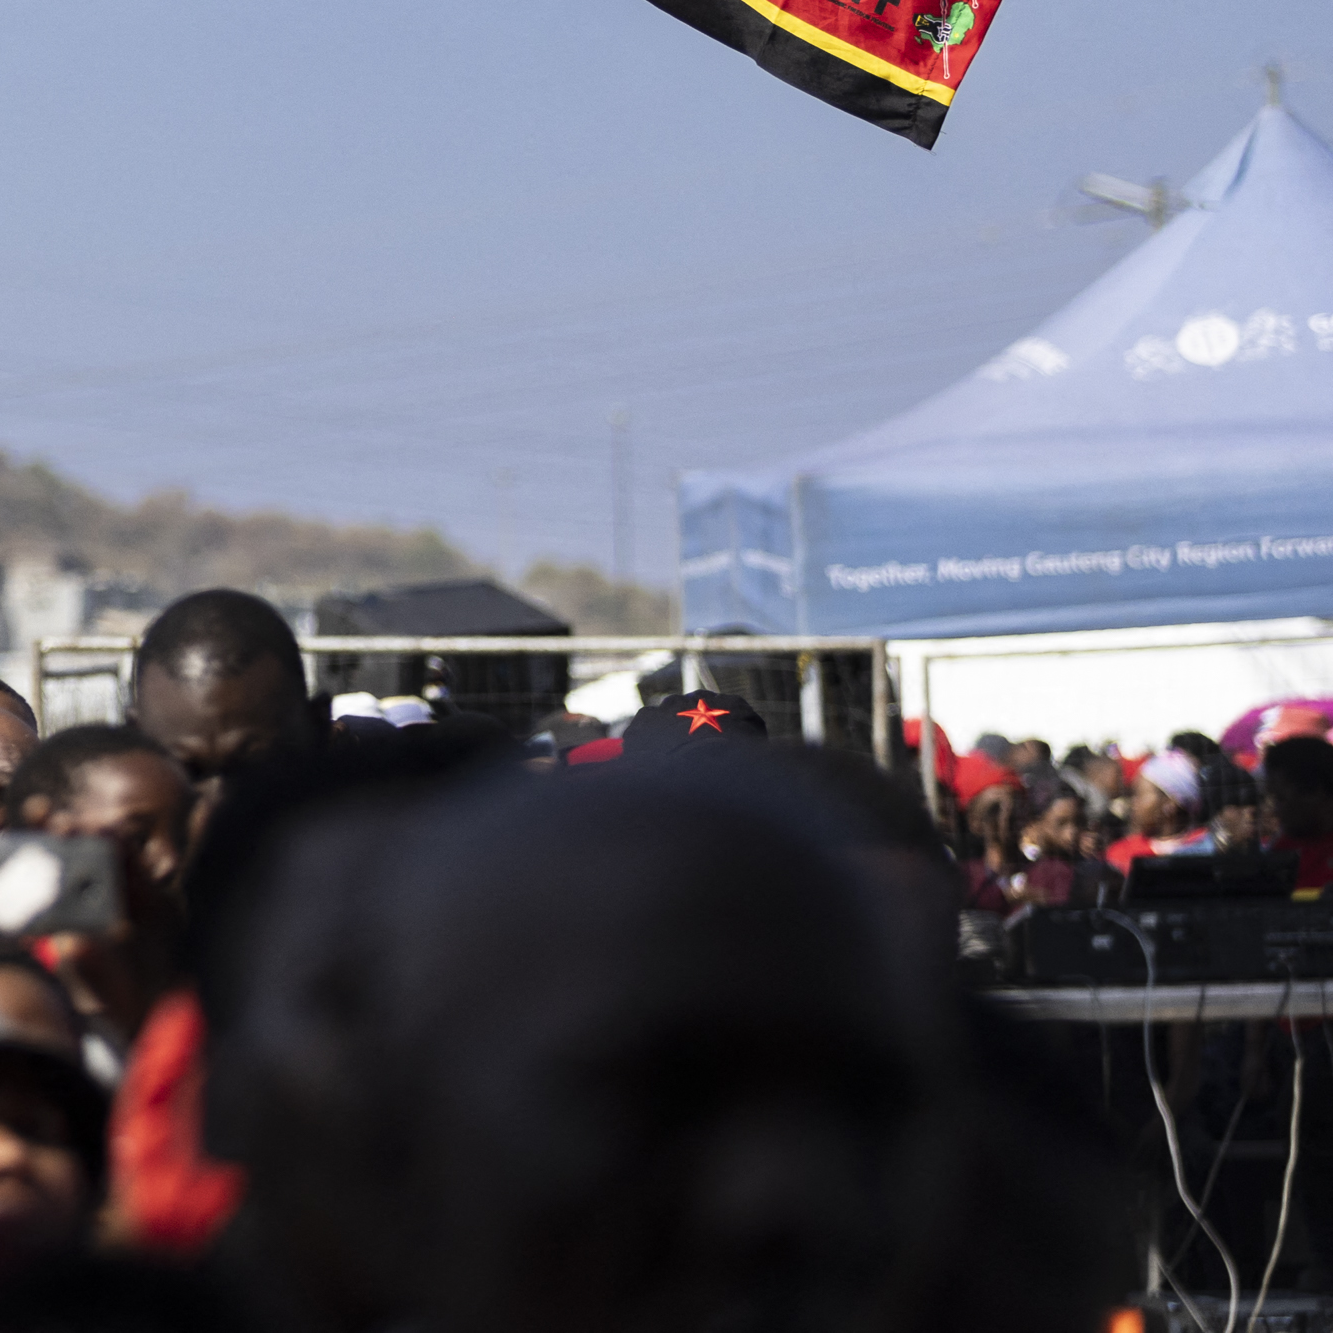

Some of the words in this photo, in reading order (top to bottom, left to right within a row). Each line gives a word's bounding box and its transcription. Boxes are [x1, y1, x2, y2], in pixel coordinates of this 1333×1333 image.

[937, 556, 1020, 582] Moving
[1025, 549, 1122, 575] Gauteng
[1126, 544, 1171, 572] City
[1176, 541, 1255, 568] Region
